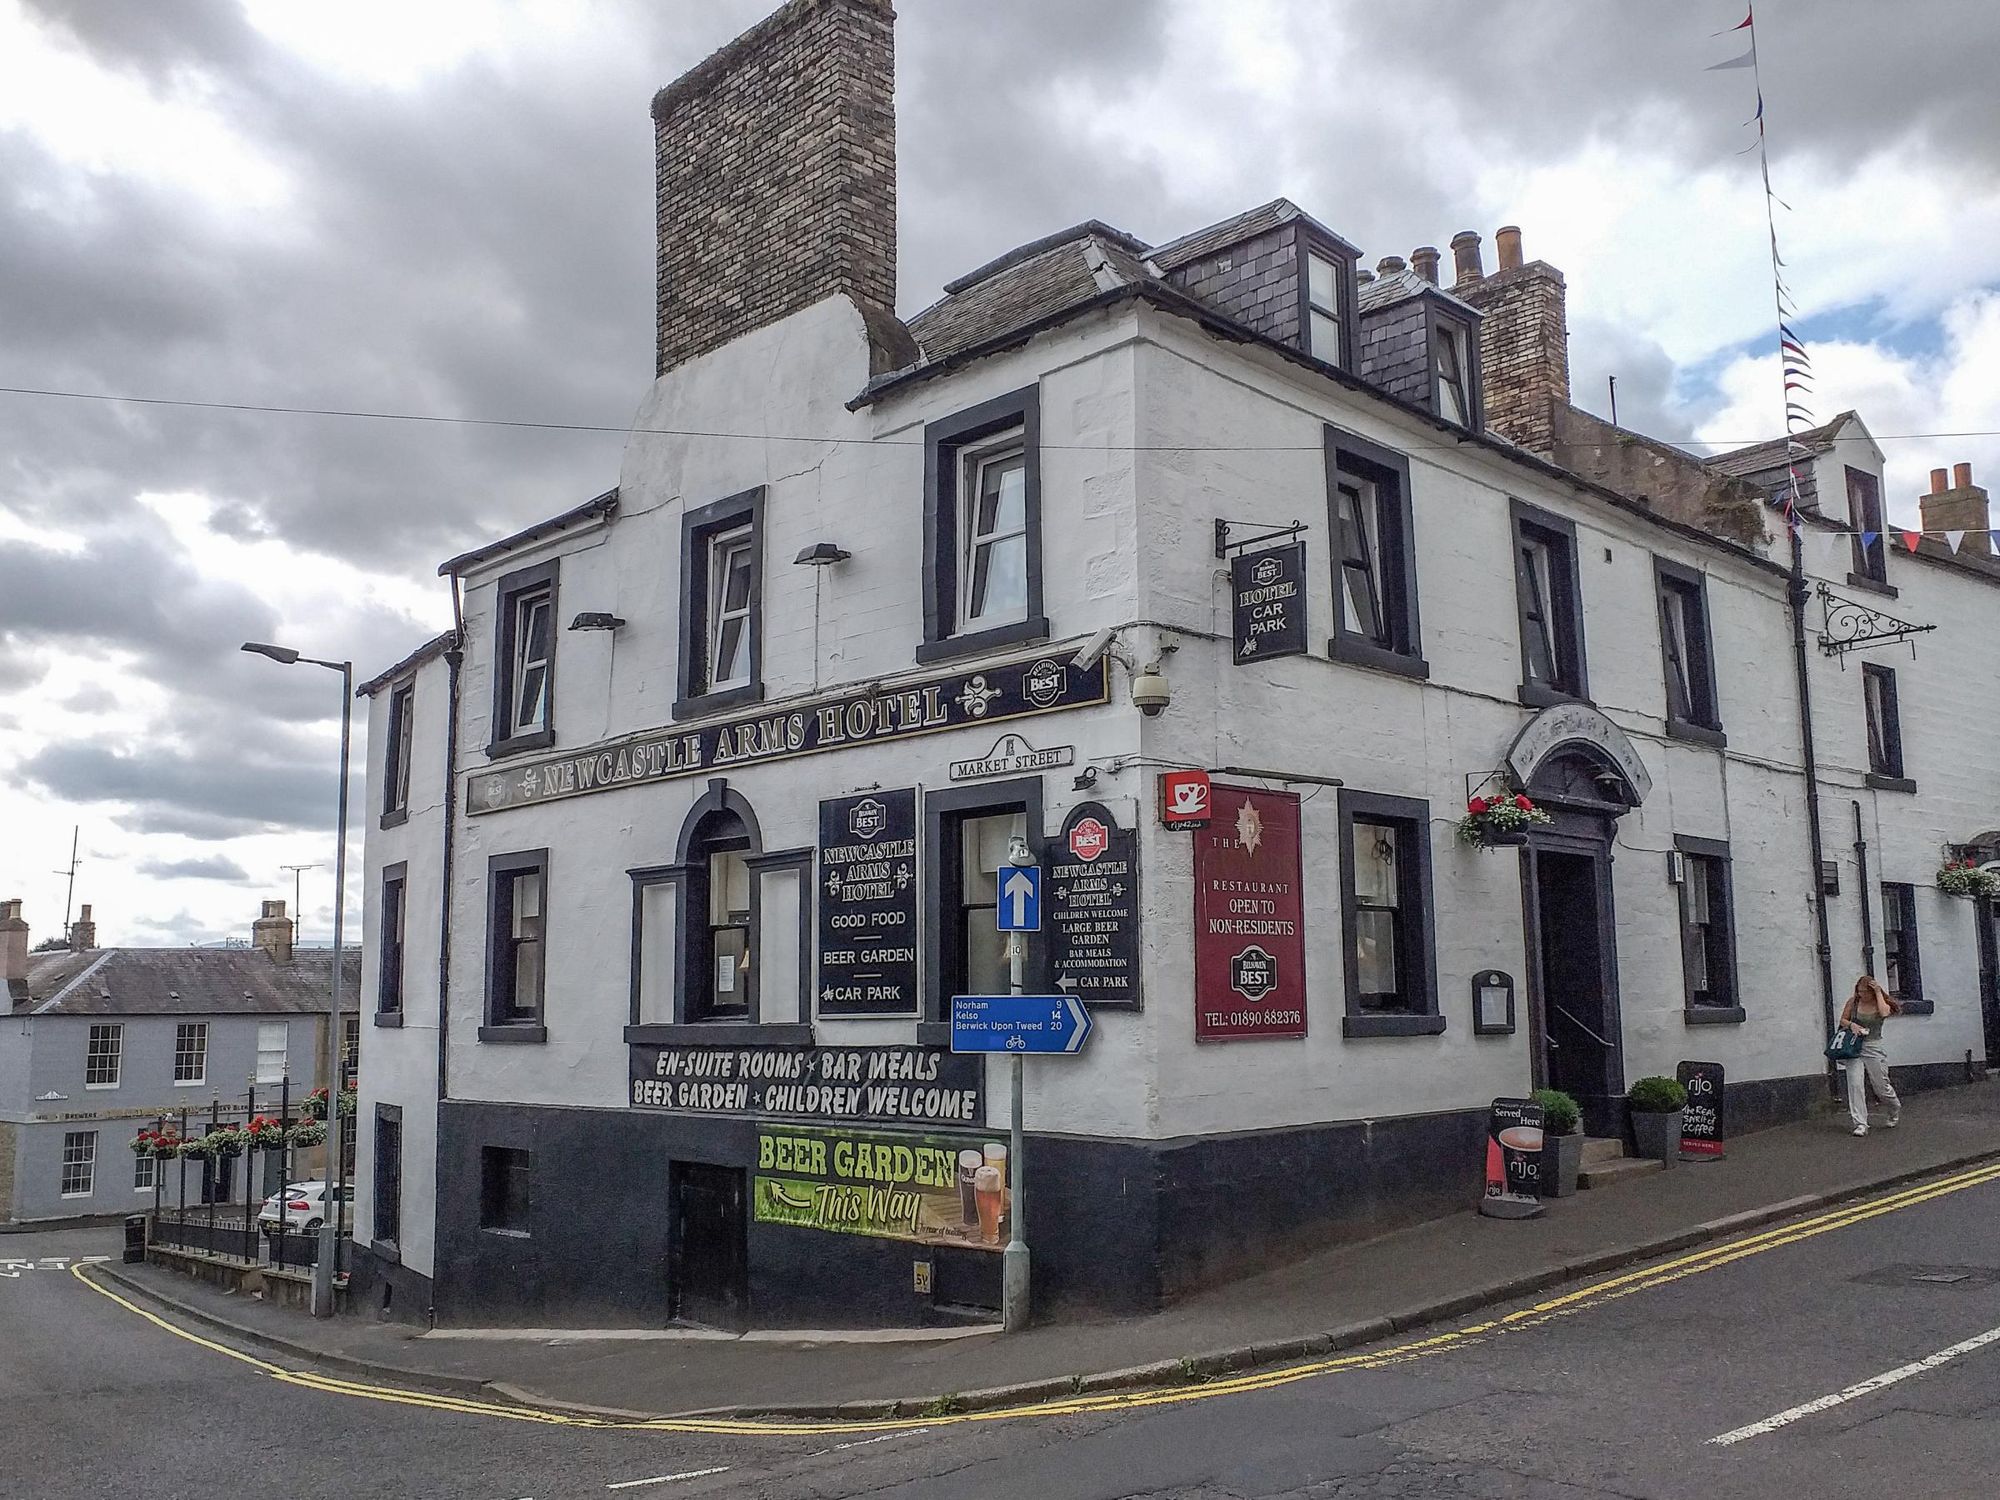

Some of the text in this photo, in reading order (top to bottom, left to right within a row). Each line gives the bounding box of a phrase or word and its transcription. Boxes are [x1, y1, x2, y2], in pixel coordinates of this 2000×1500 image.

[1257, 568, 1277, 580] BEST
[1239, 581, 1297, 608] HOTEL
[1252, 602, 1283, 619] CAR
[1250, 617, 1287, 636] PARK
[1030, 674, 1060, 692] BEST
[543, 686, 948, 796] NEWCASTLE ARMS HOTEL
[958, 750, 1062, 777] MARKET STREET
[856, 816, 880, 828] BEST
[1075, 834, 1102, 847] BEST
[1212, 837, 1240, 849] THE
[823, 839, 915, 865] NEWCASTLE
[846, 861, 891, 882] ARMS
[1052, 861, 1128, 879] NEWCASTLE
[842, 881, 895, 902] HOTEL
[1071, 878, 1108, 892] ARMS
[1213, 880, 1289, 894] RESTAURANT
[1069, 893, 1112, 908] HOTEL
[1229, 899, 1275, 914] OPEN TO
[831, 911, 906, 928] GOOD FOOD
[1053, 908, 1129, 920] CHILDREN WELCOME
[1062, 921, 1119, 933] LARGE BEER
[1209, 919, 1295, 936] NON-RESIDENTS
[1071, 934, 1110, 945] GARDEN
[823, 948, 914, 965] BEER GARDEN
[1069, 948, 1112, 958] BAR MEALS
[1054, 958, 1128, 968] & ACCOMMODATION
[1080, 976, 1129, 988] CAR PARK
[1240, 970, 1270, 985] BEST
[835, 986, 901, 1001] CAR PARK
[956, 1000, 1062, 1010] Norham 9
[956, 1011, 1062, 1020] Kelso 14
[1205, 1008, 1300, 1027] TEL: 01890 882376
[956, 1021, 1062, 1031] Berwick Upon Tweed 20
[1830, 1031, 1846, 1050] A
[656, 1051, 941, 1082] EN-SUITE ROOMS BAR MEALS
[1688, 1077, 1712, 1095] rijo
[634, 1079, 976, 1120] BEER GARDEN CHILDREN WELCOME
[1495, 1108, 1521, 1118] Served
[1520, 1117, 1540, 1126] Here
[759, 1135, 956, 1188] BEER GARDEN
[1510, 1160, 1538, 1180] rijo
[1488, 1185, 1501, 1196] rijo
[816, 1181, 921, 1233] This Way
[939, 1226, 945, 1238] of
